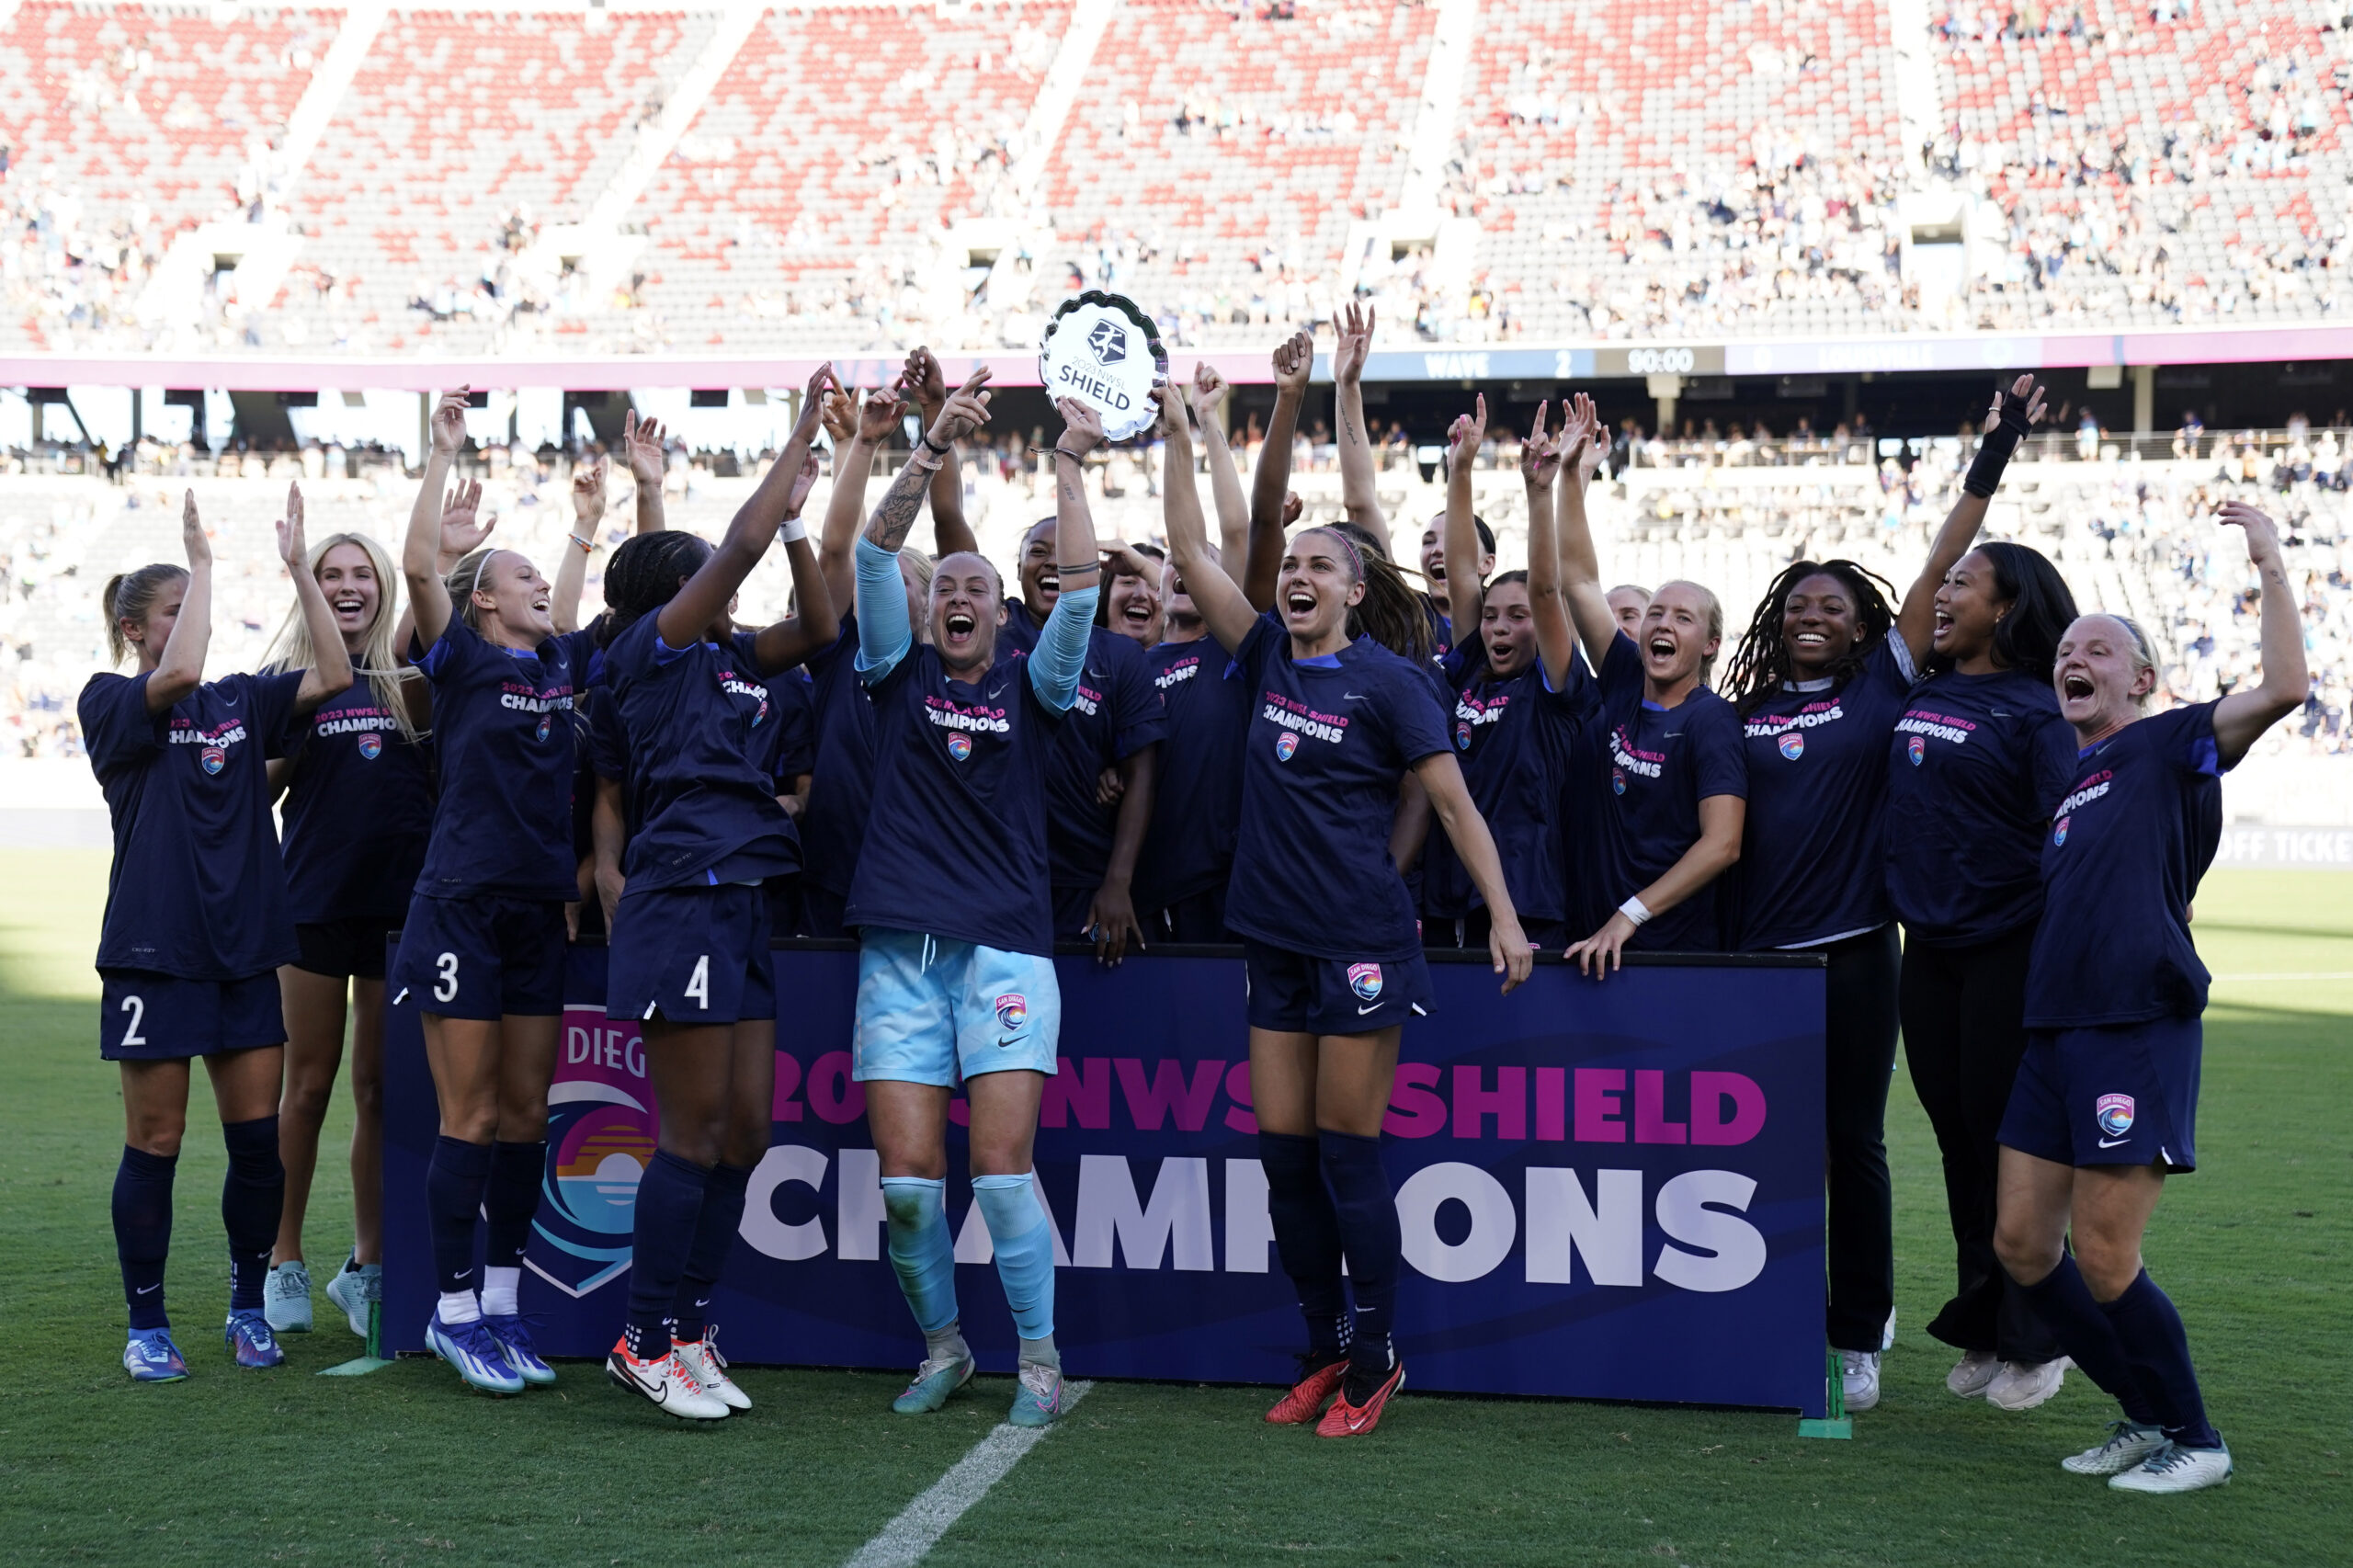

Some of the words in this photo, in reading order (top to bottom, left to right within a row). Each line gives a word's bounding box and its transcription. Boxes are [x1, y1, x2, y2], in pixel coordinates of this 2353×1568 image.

[1072, 356, 1097, 375] 2023
[1097, 369, 1125, 391] NWSL
[1425, 352, 1490, 379] WAVE
[1554, 349, 1572, 379] 2
[1628, 347, 1695, 374] 90:00
[1059, 364, 1131, 411] SHIELD
[1077, 685, 1102, 702] IELD
[317, 717, 398, 737] CHAMPIO
[1308, 710, 1349, 727] SHIELD
[1915, 710, 1941, 723] NWSL
[1940, 716, 1976, 732] SHIELD
[2077, 769, 2113, 789] IELD
[433, 952, 459, 1003] 3
[684, 955, 710, 1009] 4
[1350, 966, 1360, 976] SAN
[120, 995, 146, 1046] 2
[567, 1027, 646, 1078] DIEG
[1040, 1057, 1258, 1131] NWS
[1380, 1062, 1767, 1146] SHIELD
[2099, 1097, 2111, 1107] SAN
[2112, 1096, 2131, 1107] DIEGO
